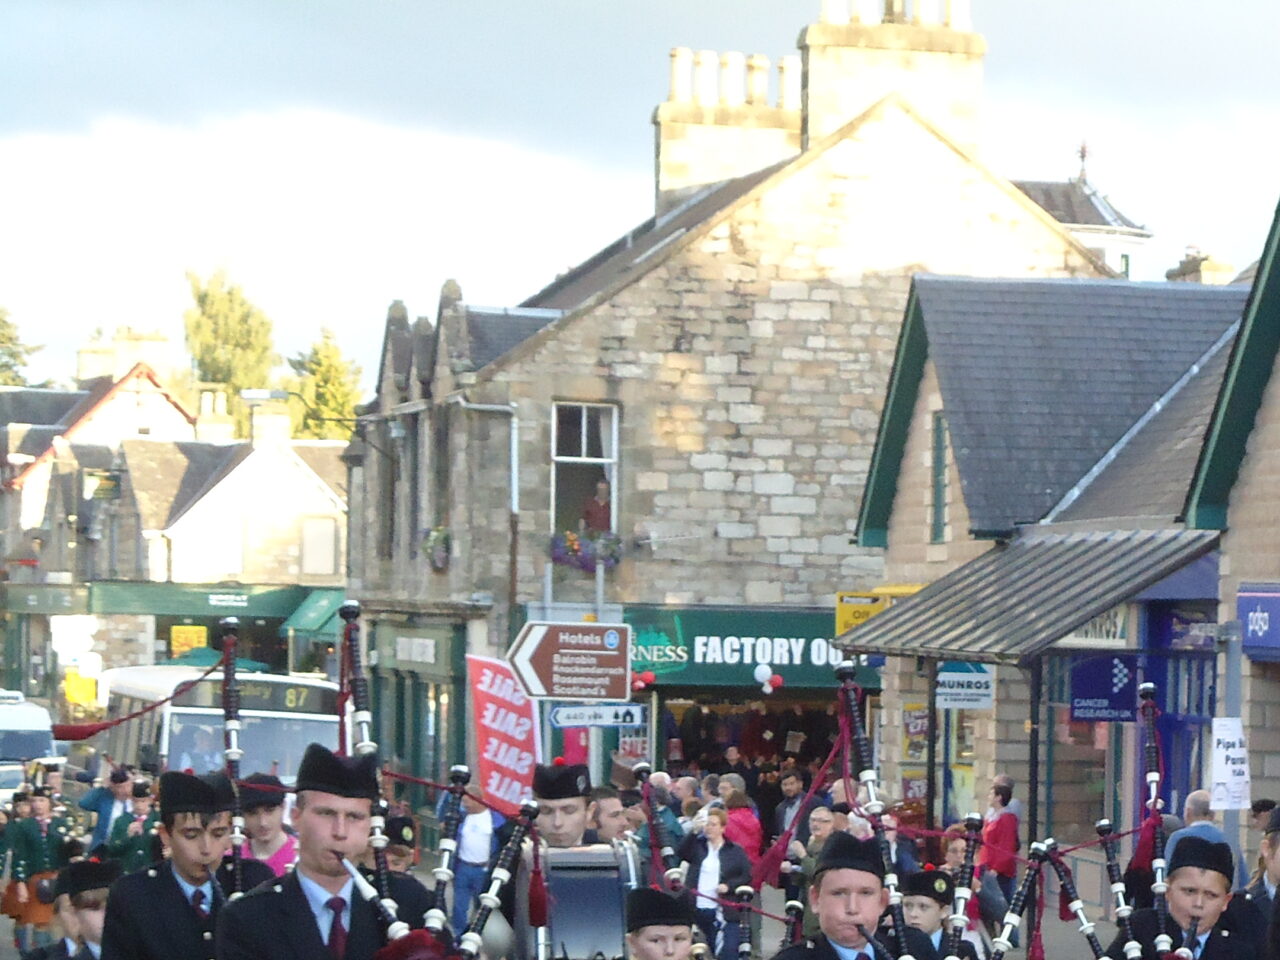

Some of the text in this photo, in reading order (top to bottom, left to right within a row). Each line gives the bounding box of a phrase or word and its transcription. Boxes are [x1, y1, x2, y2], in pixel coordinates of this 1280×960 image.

[1248, 605, 1270, 637] pdsa
[559, 632, 602, 645] Hotels
[694, 636, 806, 666] FACTORY
[553, 674, 610, 685] Rosemount
[936, 680, 990, 690] MUNROS
[553, 685, 606, 696] Scotland's
[285, 688, 308, 708] 87
[1073, 698, 1109, 708] CANCER
[1073, 707, 1132, 719] RESEARCH UK
[1216, 738, 1237, 751] Pipe
